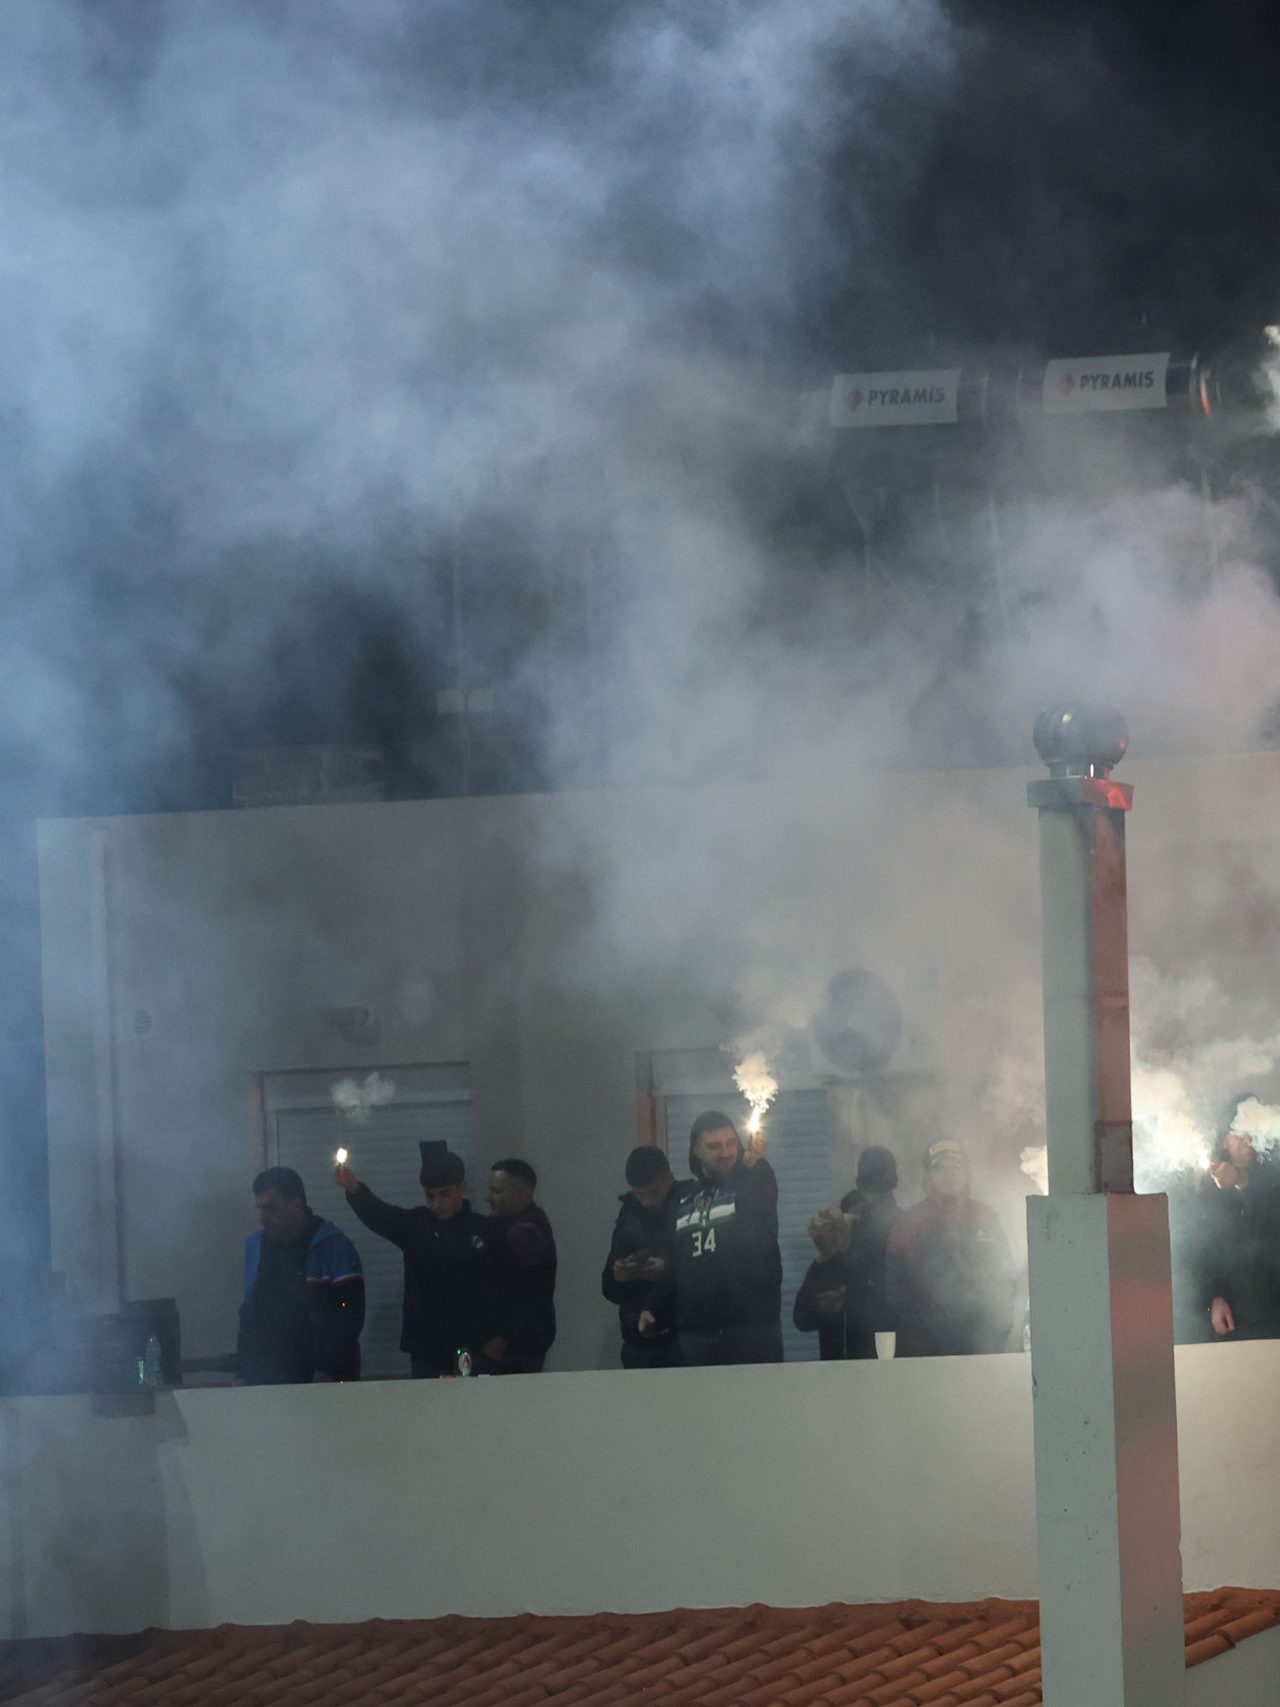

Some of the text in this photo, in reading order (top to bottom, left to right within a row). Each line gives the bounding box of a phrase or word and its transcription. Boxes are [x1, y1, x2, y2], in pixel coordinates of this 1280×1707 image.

[1080, 371, 1154, 391] PYRAMIS
[868, 387, 945, 406] PYRAMIS
[692, 1228, 716, 1257] 34
